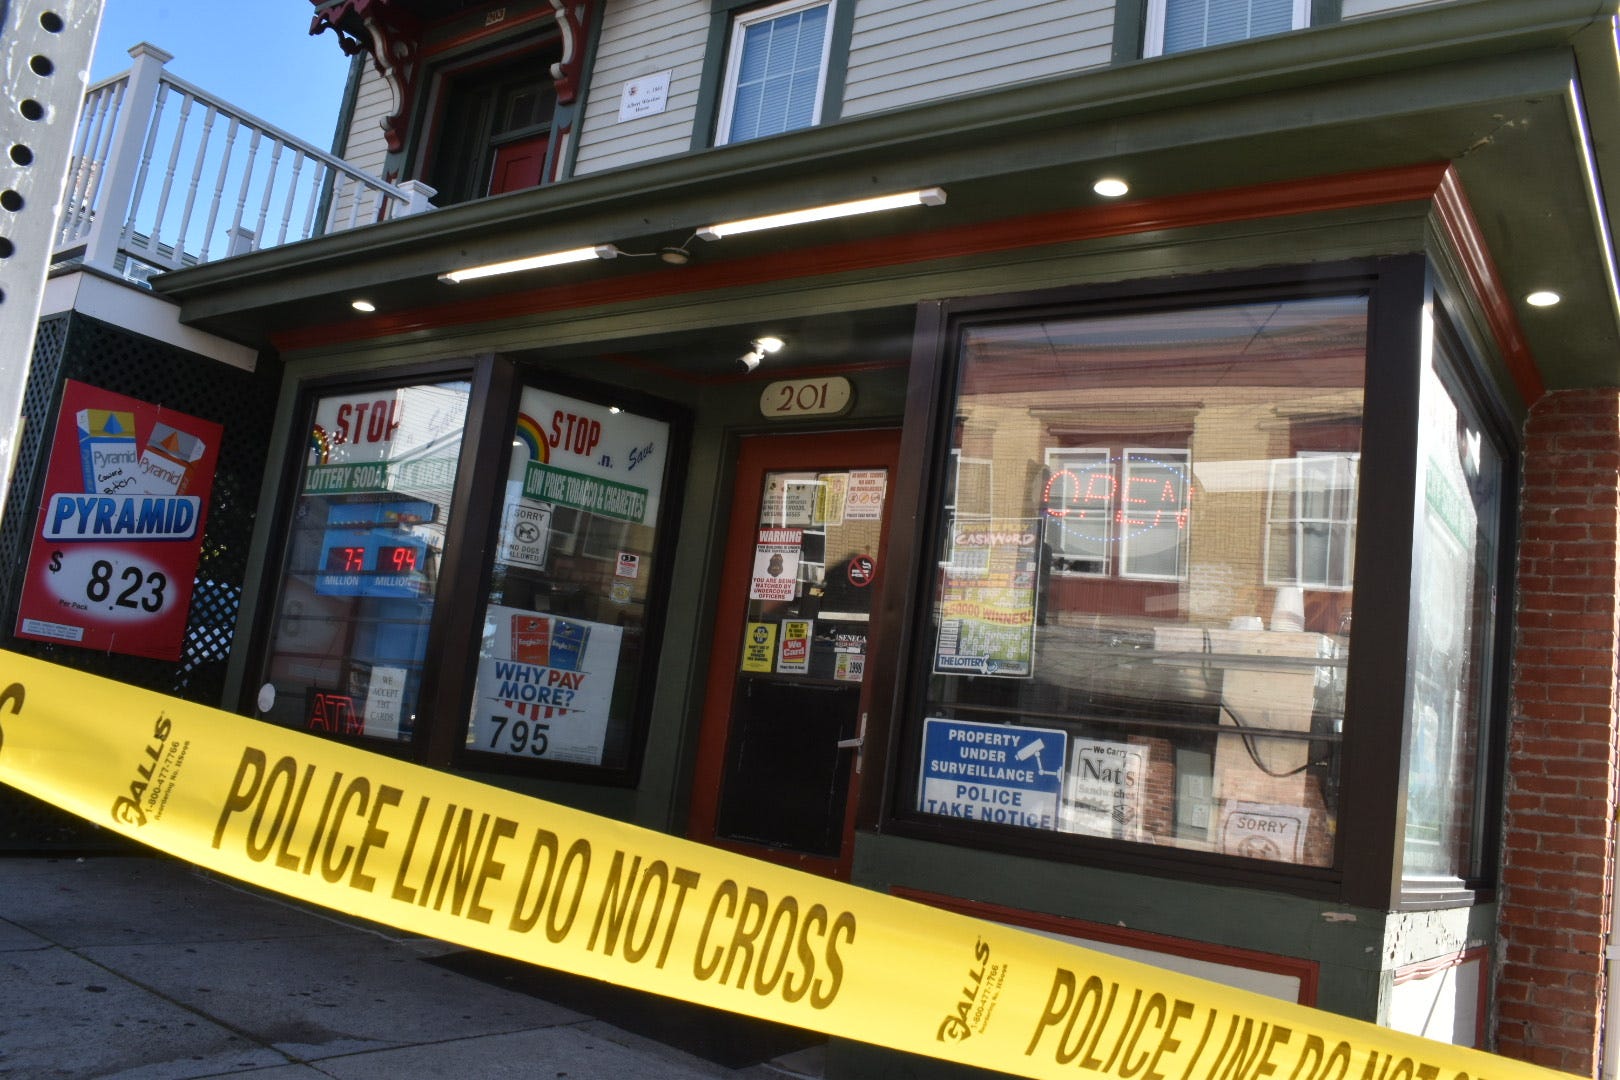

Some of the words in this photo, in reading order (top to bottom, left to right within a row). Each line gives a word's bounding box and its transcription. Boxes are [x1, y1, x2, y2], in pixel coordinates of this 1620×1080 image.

[776, 383, 828, 411] 201
[550, 410, 602, 456] STOP
[93, 450, 136, 468] Pyramid
[628, 442, 653, 470] Save
[140, 456, 182, 485] Pyramid
[305, 468, 352, 490] LOTTERY
[527, 467, 545, 495] LOW
[544, 472, 566, 500] PRICE
[565, 476, 598, 506] TOBACCO
[604, 486, 645, 519] CIGARETTES
[52, 497, 194, 535] PYRAMID
[514, 509, 545, 520] SORRY
[759, 531, 802, 543] WARNING
[955, 532, 1035, 546] CASHWORD
[393, 547, 417, 572] 94
[521, 545, 540, 555] DOGS
[49, 551, 63, 573] $
[325, 575, 359, 586] MILLION
[375, 576, 412, 588] MILLION
[72, 601, 88, 611] Pack
[983, 607, 1032, 624] WINNER!
[787, 640, 802, 648] We
[382, 676, 393, 685] WE
[495, 661, 545, 685] WHY
[547, 669, 585, 691] PAY
[372, 687, 399, 698] ACCEPT
[498, 681, 575, 707] MORE?
[310, 693, 366, 736] ATM
[370, 711, 394, 722] CARDS
[490, 716, 549, 756] 795
[949, 729, 1021, 747] PROPERTY
[960, 747, 1006, 762] UNDER
[1093, 745, 1105, 754] We
[1106, 747, 1128, 758] Carry
[111, 715, 172, 827] GALLS
[145, 741, 180, 813] 1-800-477-7766
[931, 760, 1034, 782] SURVEILLANCE
[154, 782, 175, 820] Reordering
[956, 785, 1022, 806] POLICE
[928, 799, 974, 819] TAKE
[981, 807, 1051, 829] NOTICE
[1237, 817, 1288, 833] SORRY
[212, 746, 404, 893] POLICE
[391, 796, 519, 924] LINE
[508, 827, 592, 944] DO
[586, 850, 701, 970] NOT
[693, 879, 857, 1010] CROSS
[936, 939, 990, 1042] GALLS
[971, 963, 999, 1028] 1-800-477-7766
[1024, 967, 1195, 1080] POLICE
